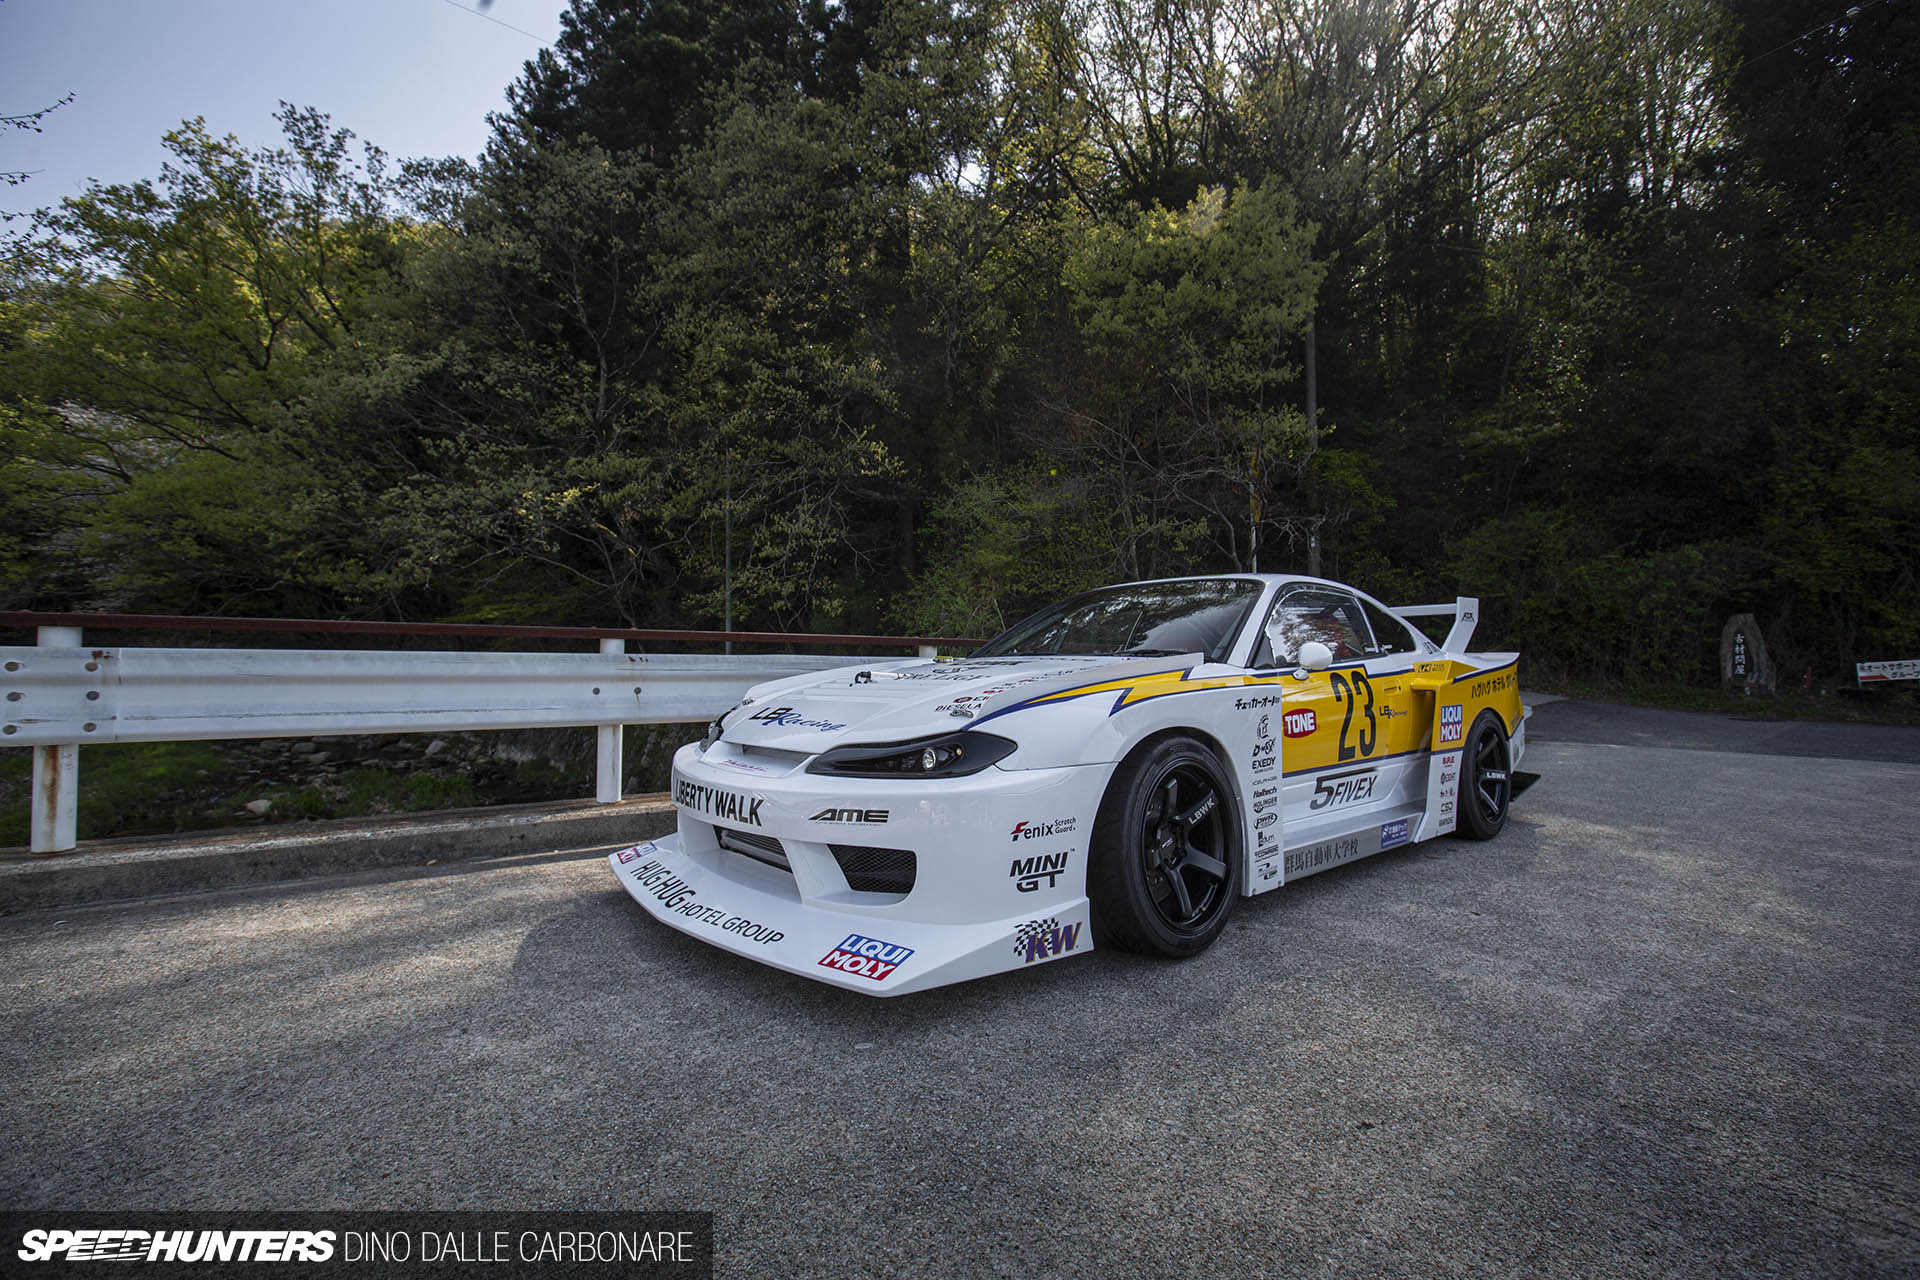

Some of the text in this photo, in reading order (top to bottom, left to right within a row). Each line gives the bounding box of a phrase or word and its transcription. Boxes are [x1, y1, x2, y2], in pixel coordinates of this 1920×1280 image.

[1284, 712, 1316, 734] TONE
[1330, 671, 1377, 761] 23
[1441, 706, 1462, 723] LIQUI
[1441, 723, 1462, 741] MOLY
[1252, 757, 1276, 769] EXEDY
[675, 779, 765, 826] LIBERTY WALK
[1188, 797, 1215, 824] LBWK
[808, 808, 889, 823] AME
[1054, 817, 1077, 827] Scratch
[1011, 821, 1054, 842] Fenix
[1010, 851, 1068, 877] MINI
[1016, 869, 1064, 893] GT
[630, 860, 785, 944] HUG HUG HOTEL GROUP
[839, 935, 912, 964] LIQUI
[1025, 921, 1083, 963] KW
[821, 950, 898, 979] MOLY
